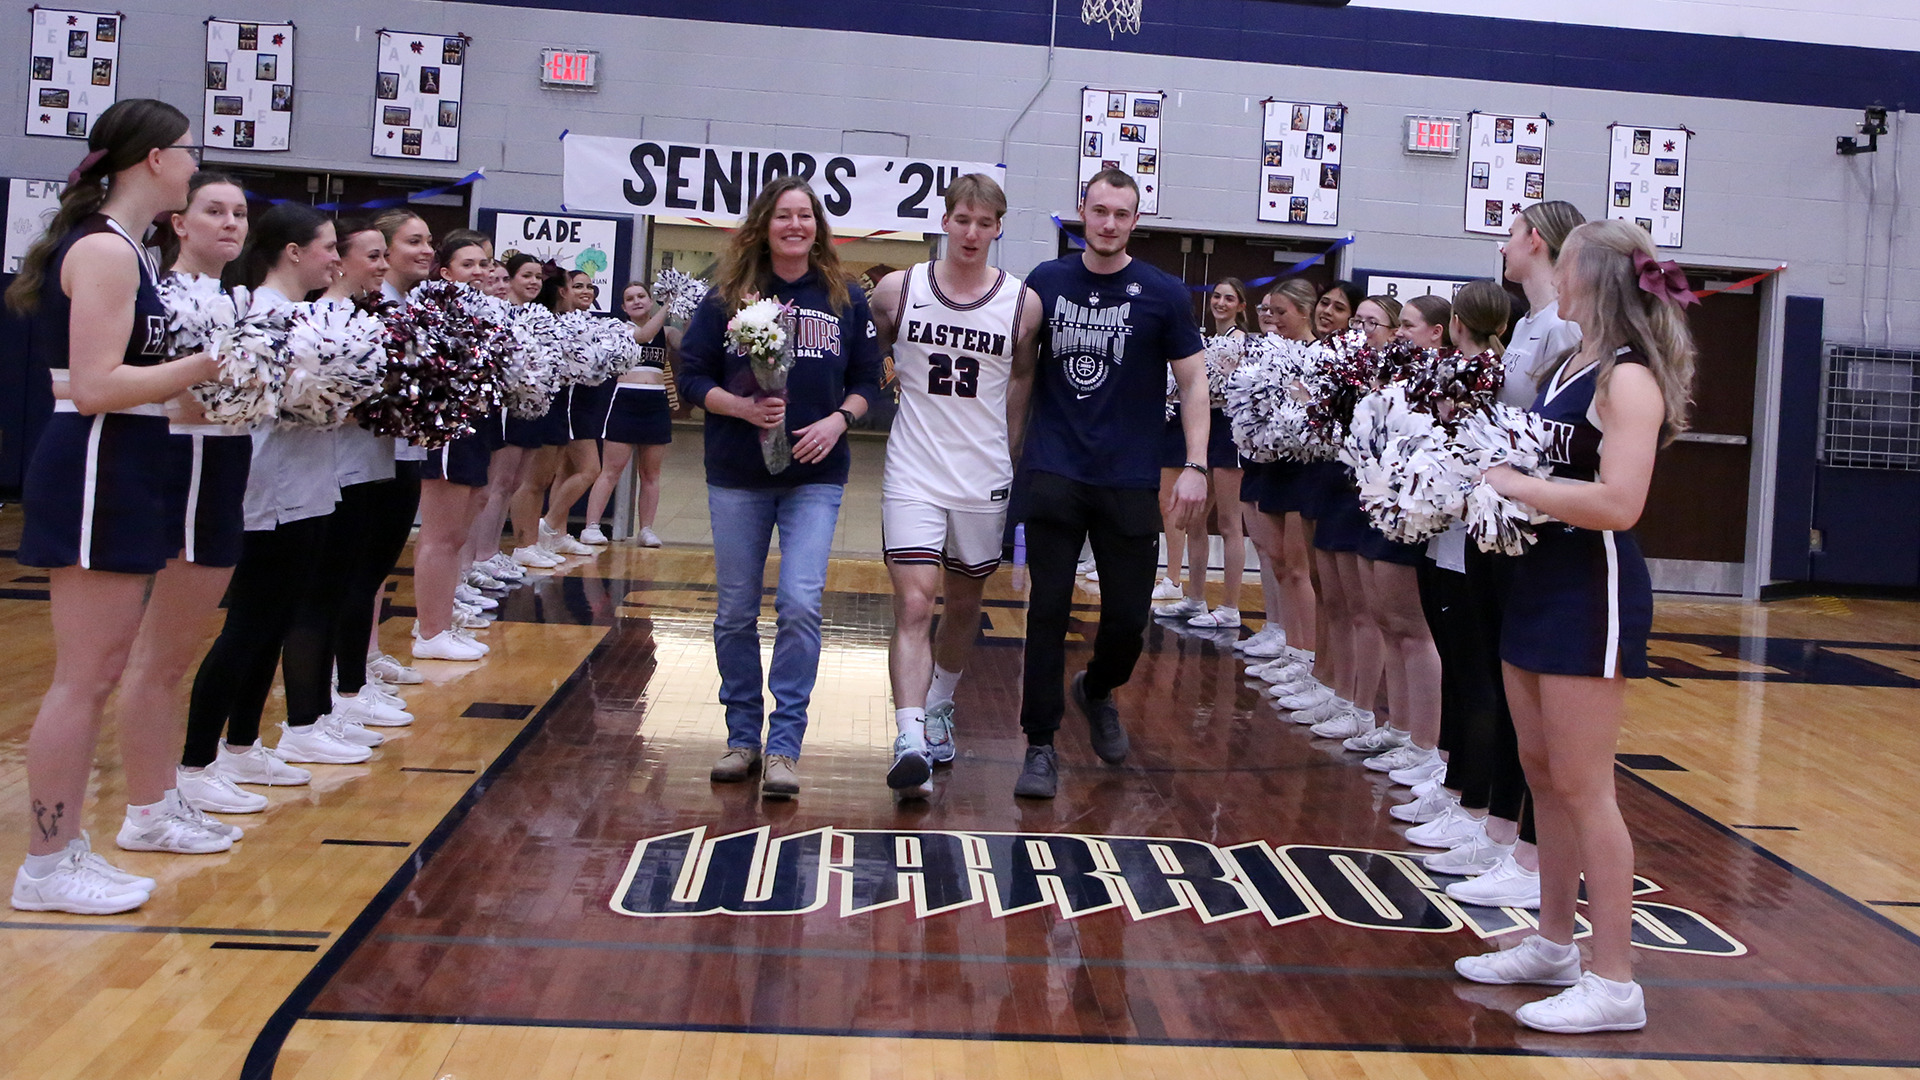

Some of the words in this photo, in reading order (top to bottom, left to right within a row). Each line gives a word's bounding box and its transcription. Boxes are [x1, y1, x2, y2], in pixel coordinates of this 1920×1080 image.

[552, 53, 589, 81] EXIT
[1417, 122, 1451, 147] EXIT
[523, 216, 582, 243] CADE
[907, 320, 1006, 356] EASTERN
[928, 352, 980, 398] 23
